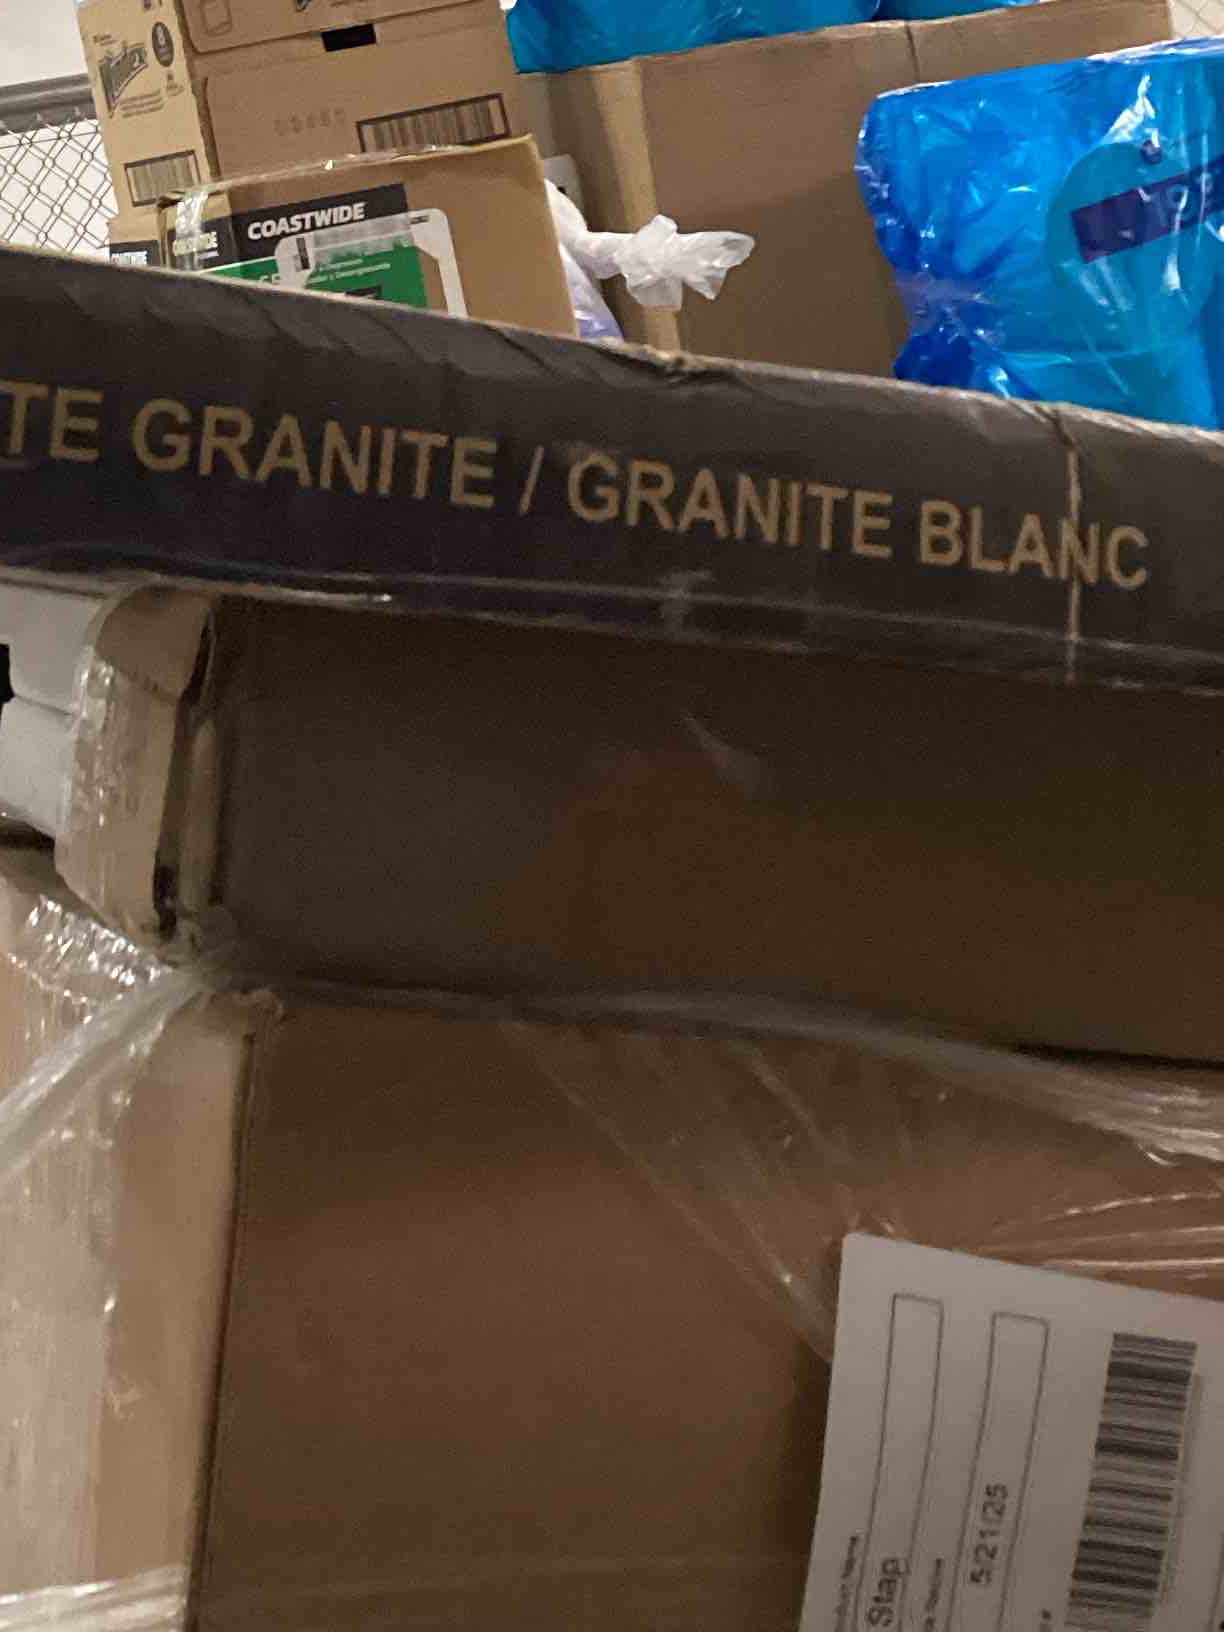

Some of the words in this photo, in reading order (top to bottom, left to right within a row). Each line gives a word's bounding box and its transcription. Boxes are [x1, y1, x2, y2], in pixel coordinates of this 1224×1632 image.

[247, 202, 366, 240] COASTWIDE
[132, 398, 497, 509] GRANITE
[566, 450, 894, 559] GRANITE
[919, 499, 1149, 588] BLANC
[864, 1557, 912, 1627] Stap
